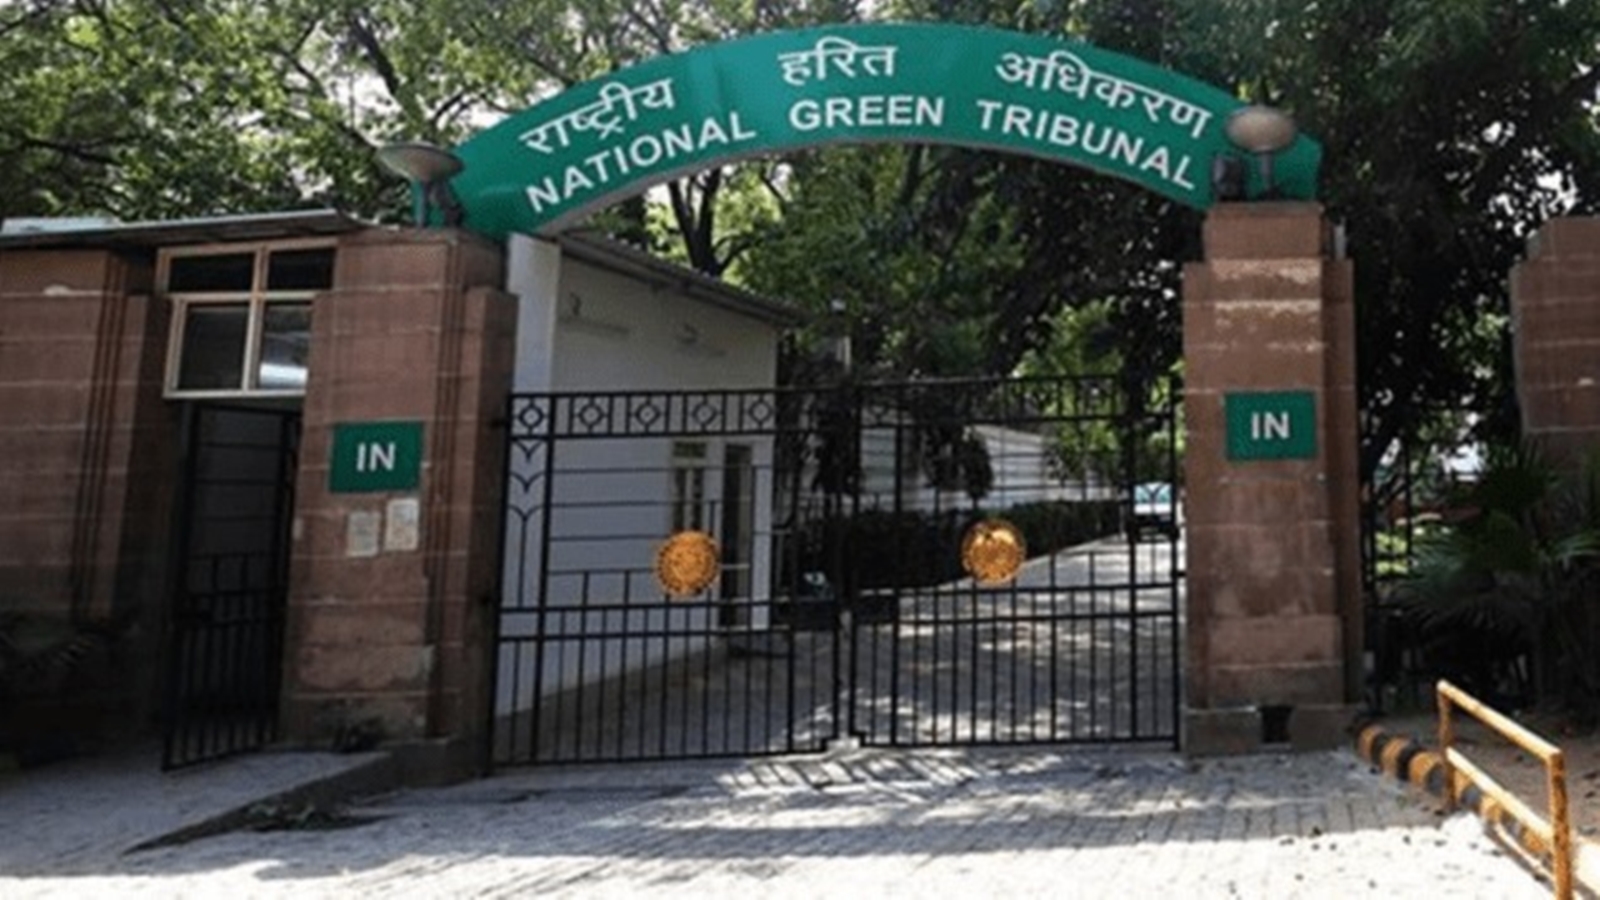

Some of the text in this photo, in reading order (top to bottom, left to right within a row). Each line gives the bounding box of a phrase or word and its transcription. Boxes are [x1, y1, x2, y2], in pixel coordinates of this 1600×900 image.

[519, 36, 1212, 155] राष्ट्रीय हरित अधिकरण
[525, 95, 1196, 213] NATIONAL GREEN TRIBUNAL
[356, 442, 396, 472] IN
[1251, 411, 1290, 440] IN
